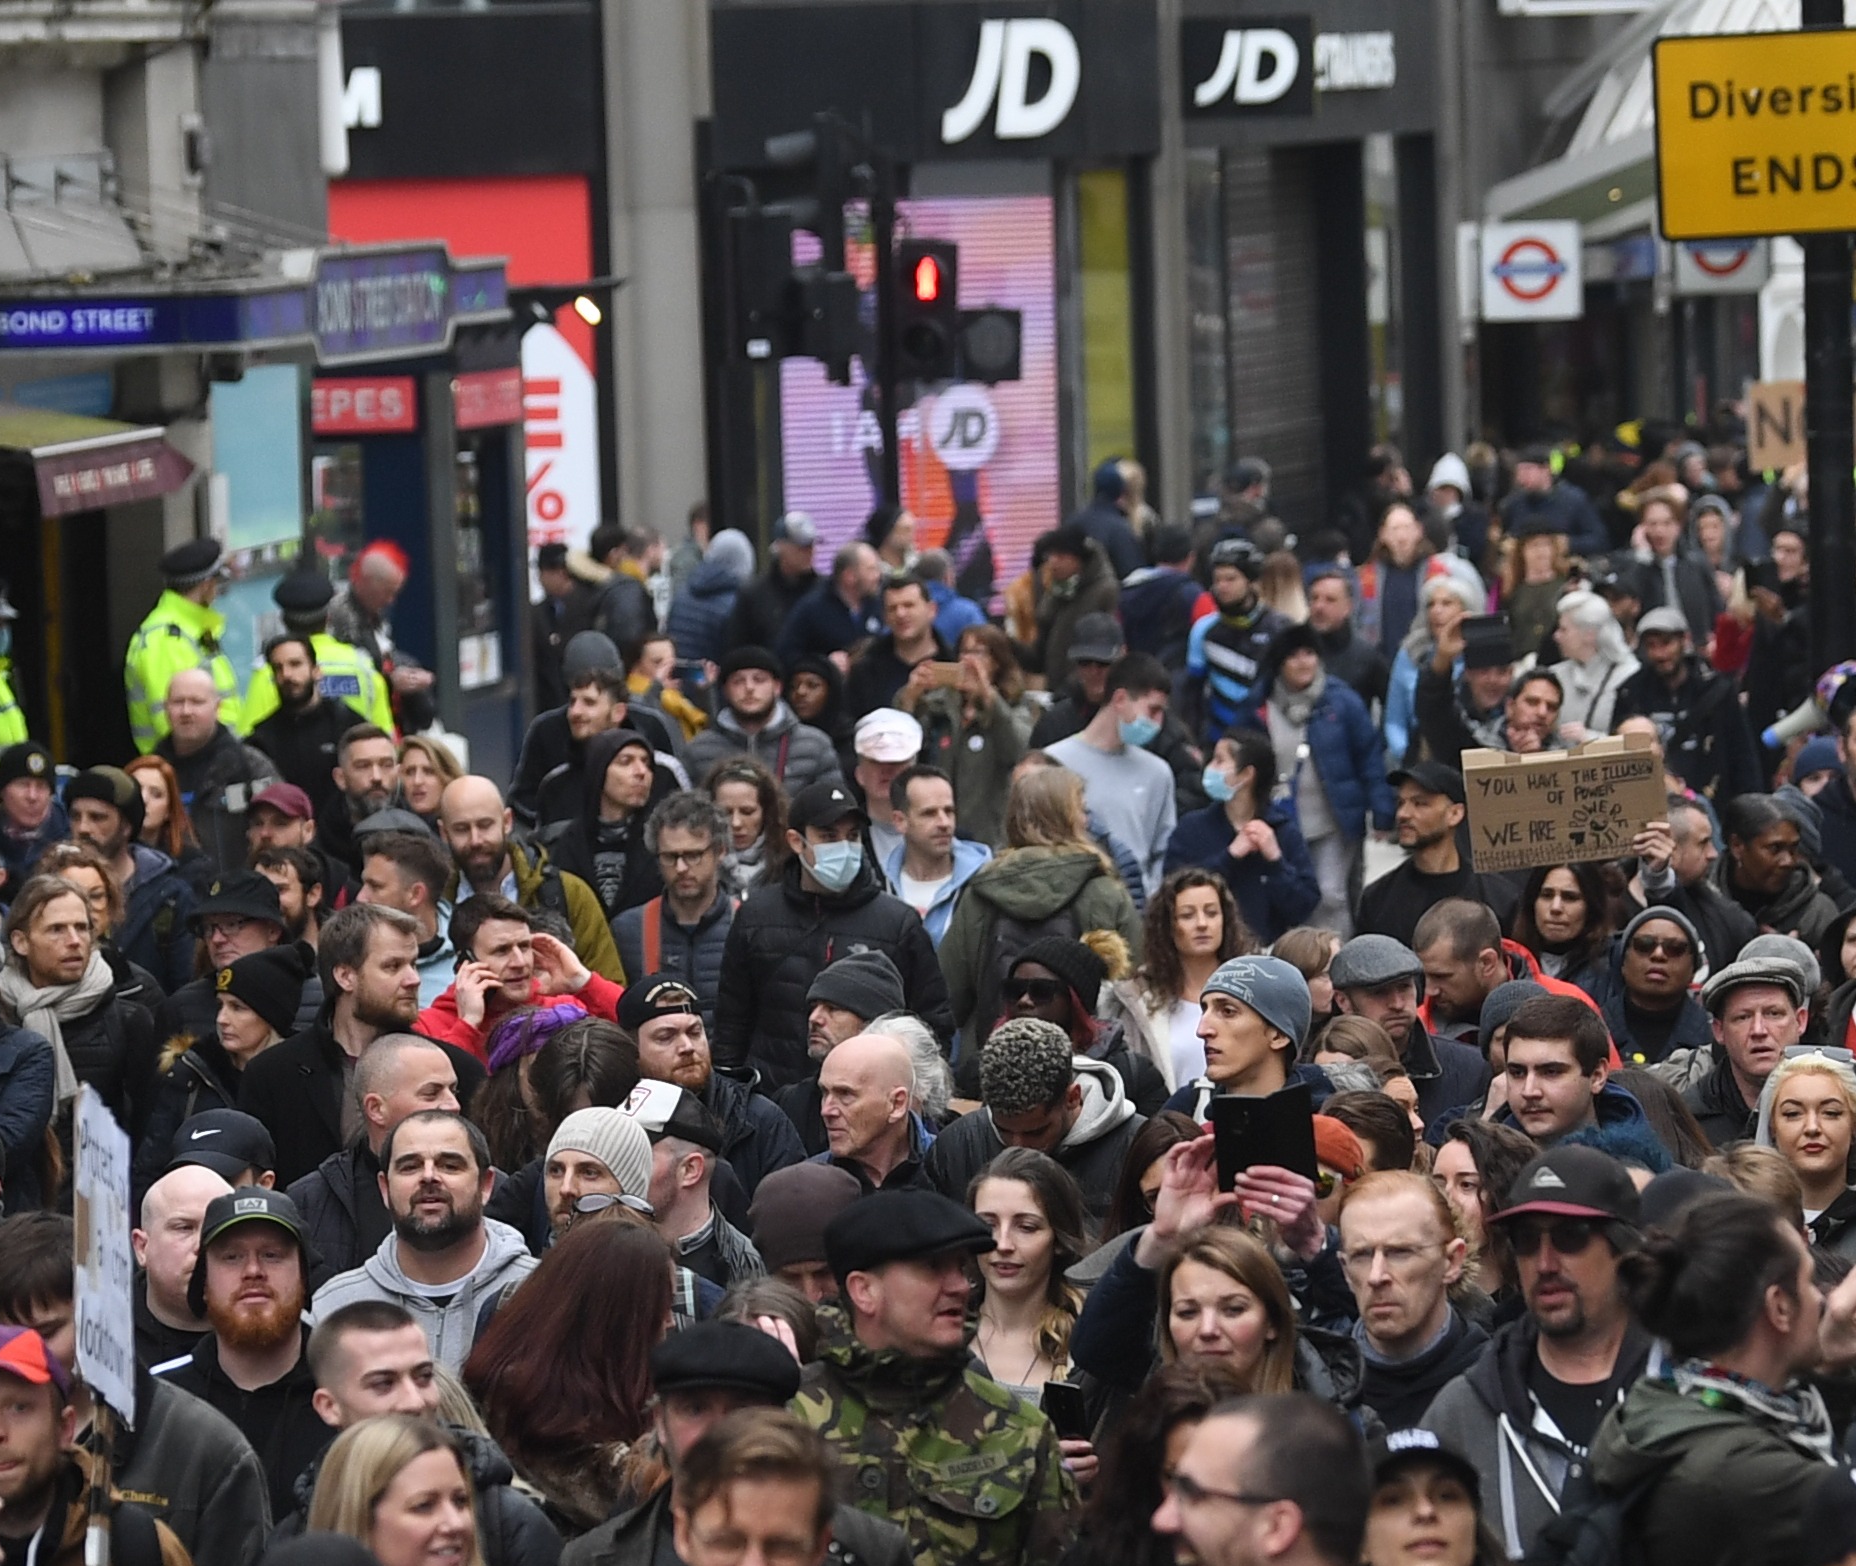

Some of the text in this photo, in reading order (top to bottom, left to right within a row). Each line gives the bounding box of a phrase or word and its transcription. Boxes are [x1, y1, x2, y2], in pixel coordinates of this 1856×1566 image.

[942, 17, 1080, 143] JD
[1194, 28, 1300, 107] JD
[70, 306, 155, 334] STREET
[1477, 776, 1517, 797] YOU
[1527, 772, 1559, 791] HAVE
[1571, 766, 1598, 785] THE
[1546, 783, 1615, 805] OF POWER
[1482, 820, 1523, 847] WE
[1529, 818, 1557, 844] ARE
